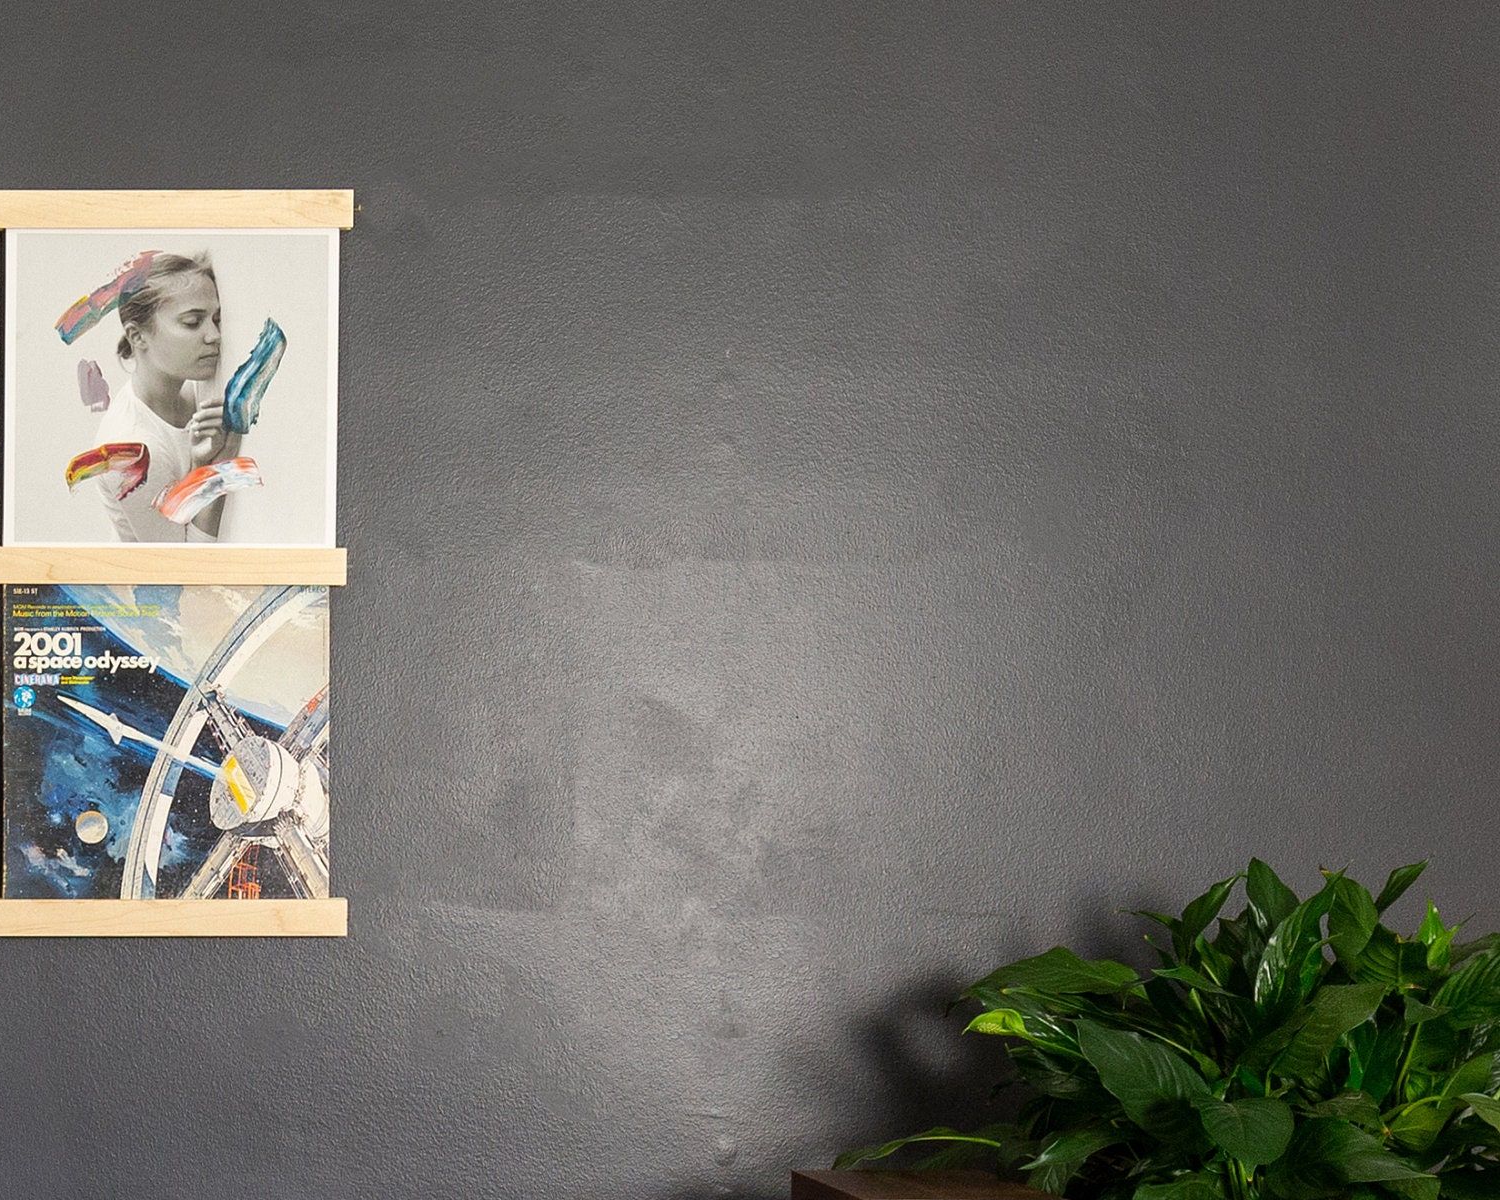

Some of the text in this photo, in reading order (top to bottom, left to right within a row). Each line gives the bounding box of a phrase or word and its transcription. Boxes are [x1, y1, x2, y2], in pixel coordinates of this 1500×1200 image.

[13, 632, 82, 656] 2001
[13, 650, 160, 673] a space odyssey
[14, 673, 60, 686] CINERAMA
